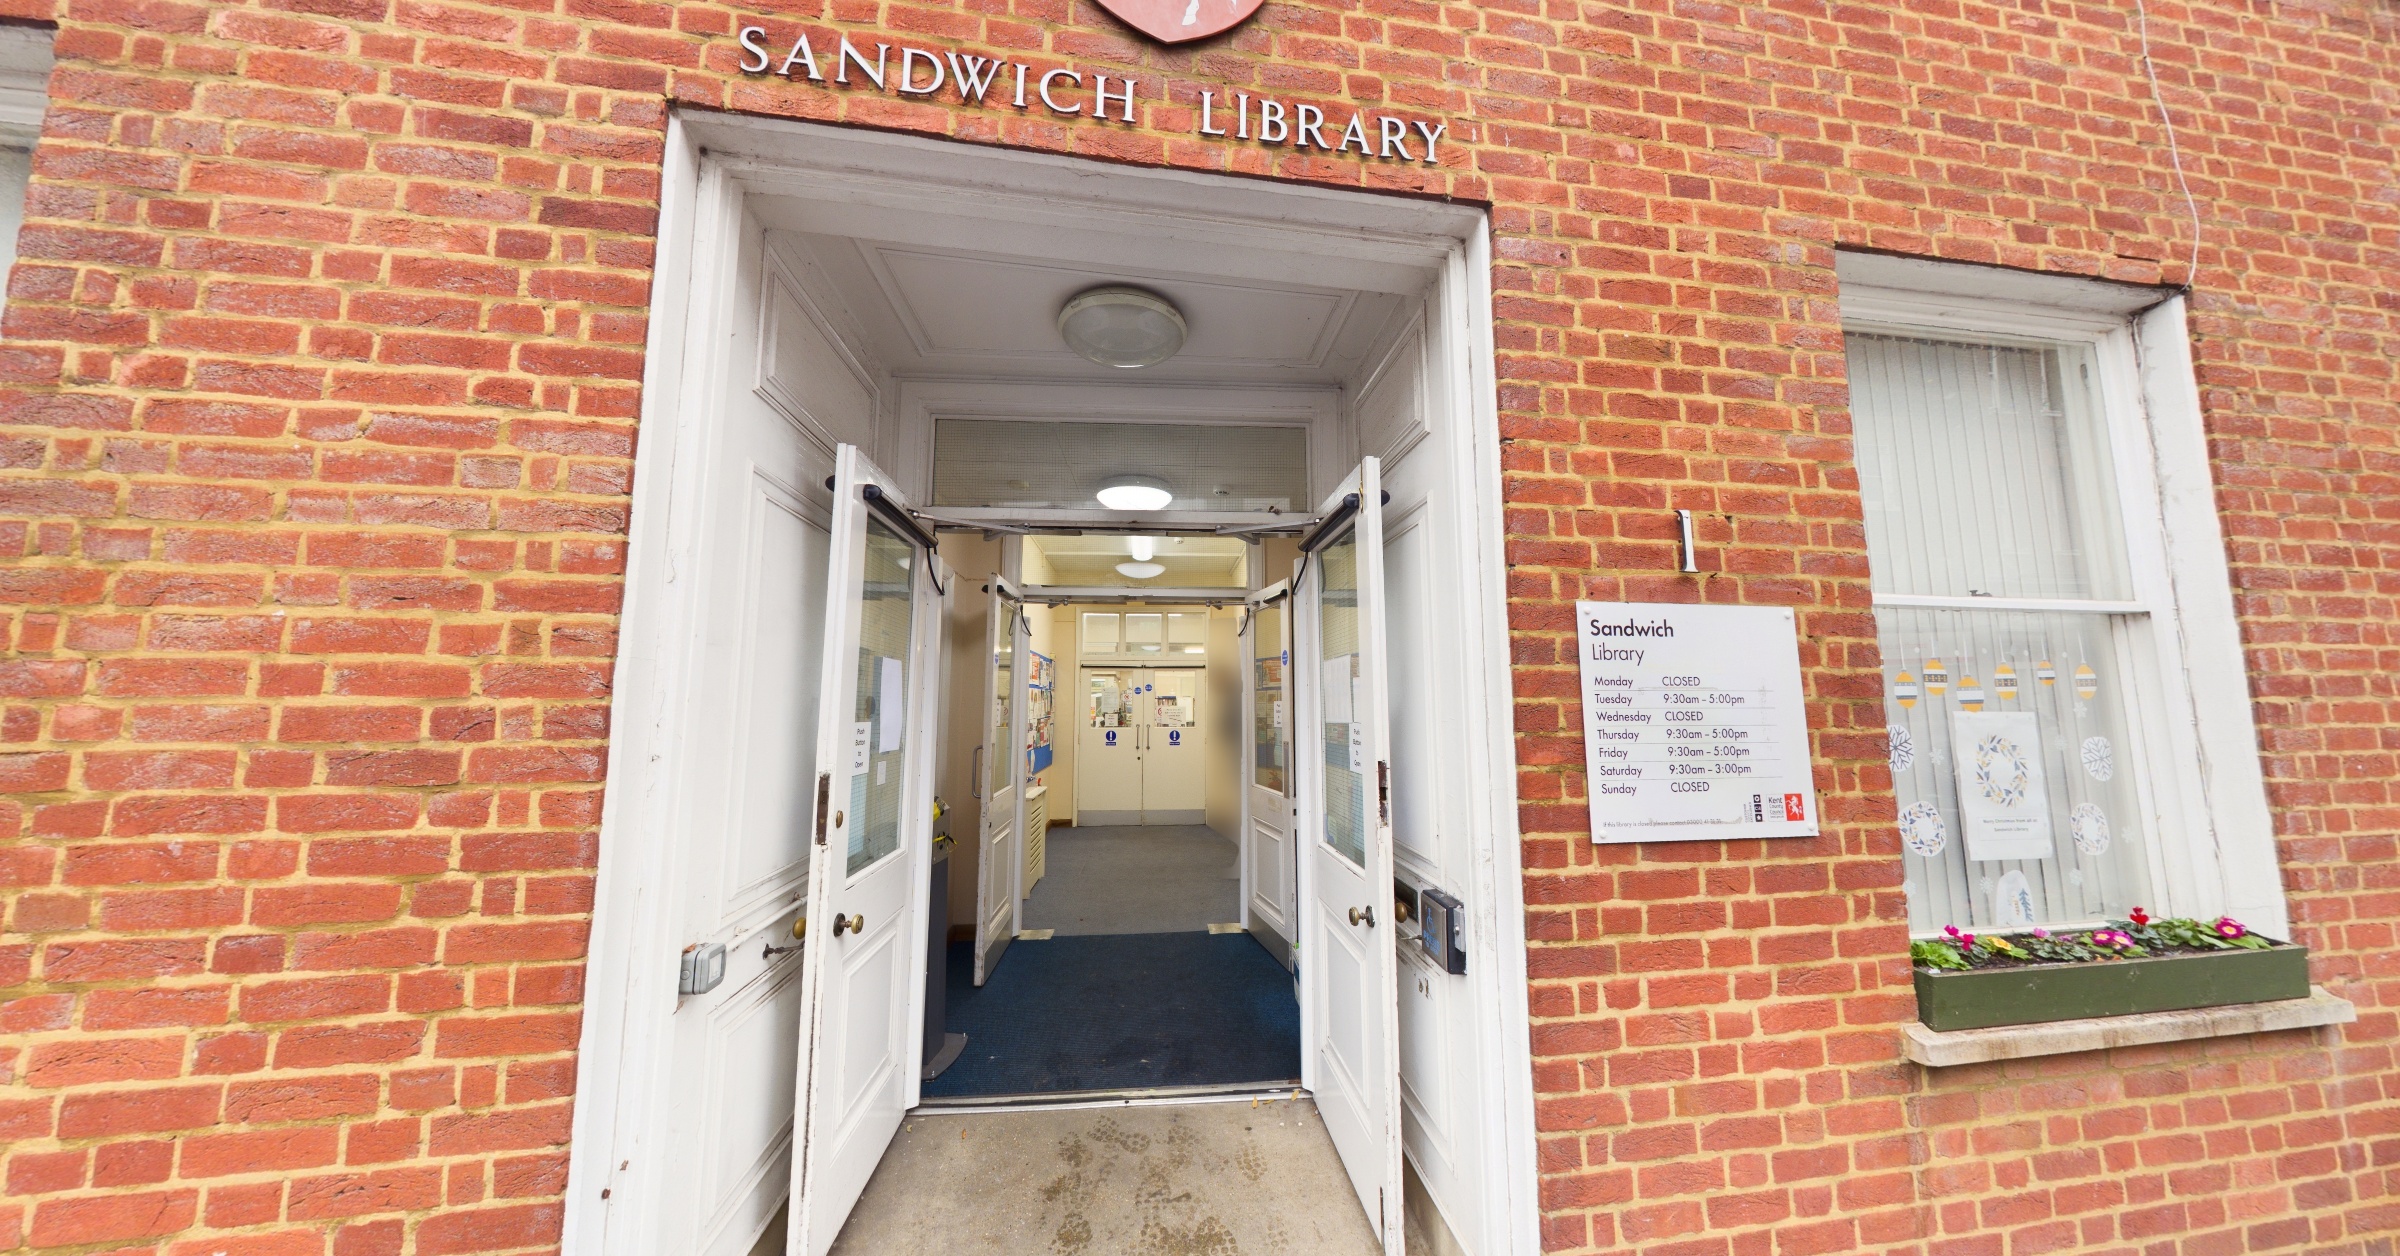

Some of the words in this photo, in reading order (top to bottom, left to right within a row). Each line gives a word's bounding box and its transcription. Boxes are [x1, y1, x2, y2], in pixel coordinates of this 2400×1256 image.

[739, 26, 1137, 123] SANDWICH
[1198, 91, 1447, 164] LIBRARY
[1590, 618, 1674, 637] Sandwich
[1592, 642, 1645, 666] Library
[1594, 676, 1634, 688] Monday
[1662, 676, 1701, 687] CLOSED
[1595, 694, 1633, 706] Tuesday
[1663, 694, 1700, 704] 9:30am
[1709, 694, 1745, 706] 5:00pm
[1596, 711, 1652, 724] Wednesday
[1665, 711, 1704, 721] CLOSED
[1597, 729, 1640, 742] Thursday
[1666, 729, 1703, 739] 9:30am
[1712, 728, 1749, 740] 5:00pm
[1599, 747, 1628, 760] Friday
[1668, 746, 1704, 757] 9:30am
[1714, 746, 1750, 758] 5:00pm
[1600, 765, 1642, 778] Saturday
[1669, 764, 1706, 775] 9:30am
[1715, 763, 1752, 776] 3:00pm
[1601, 783, 1637, 795] Sunday
[1670, 782, 1710, 793] CLOSED
[1768, 796, 1783, 804] Kent
